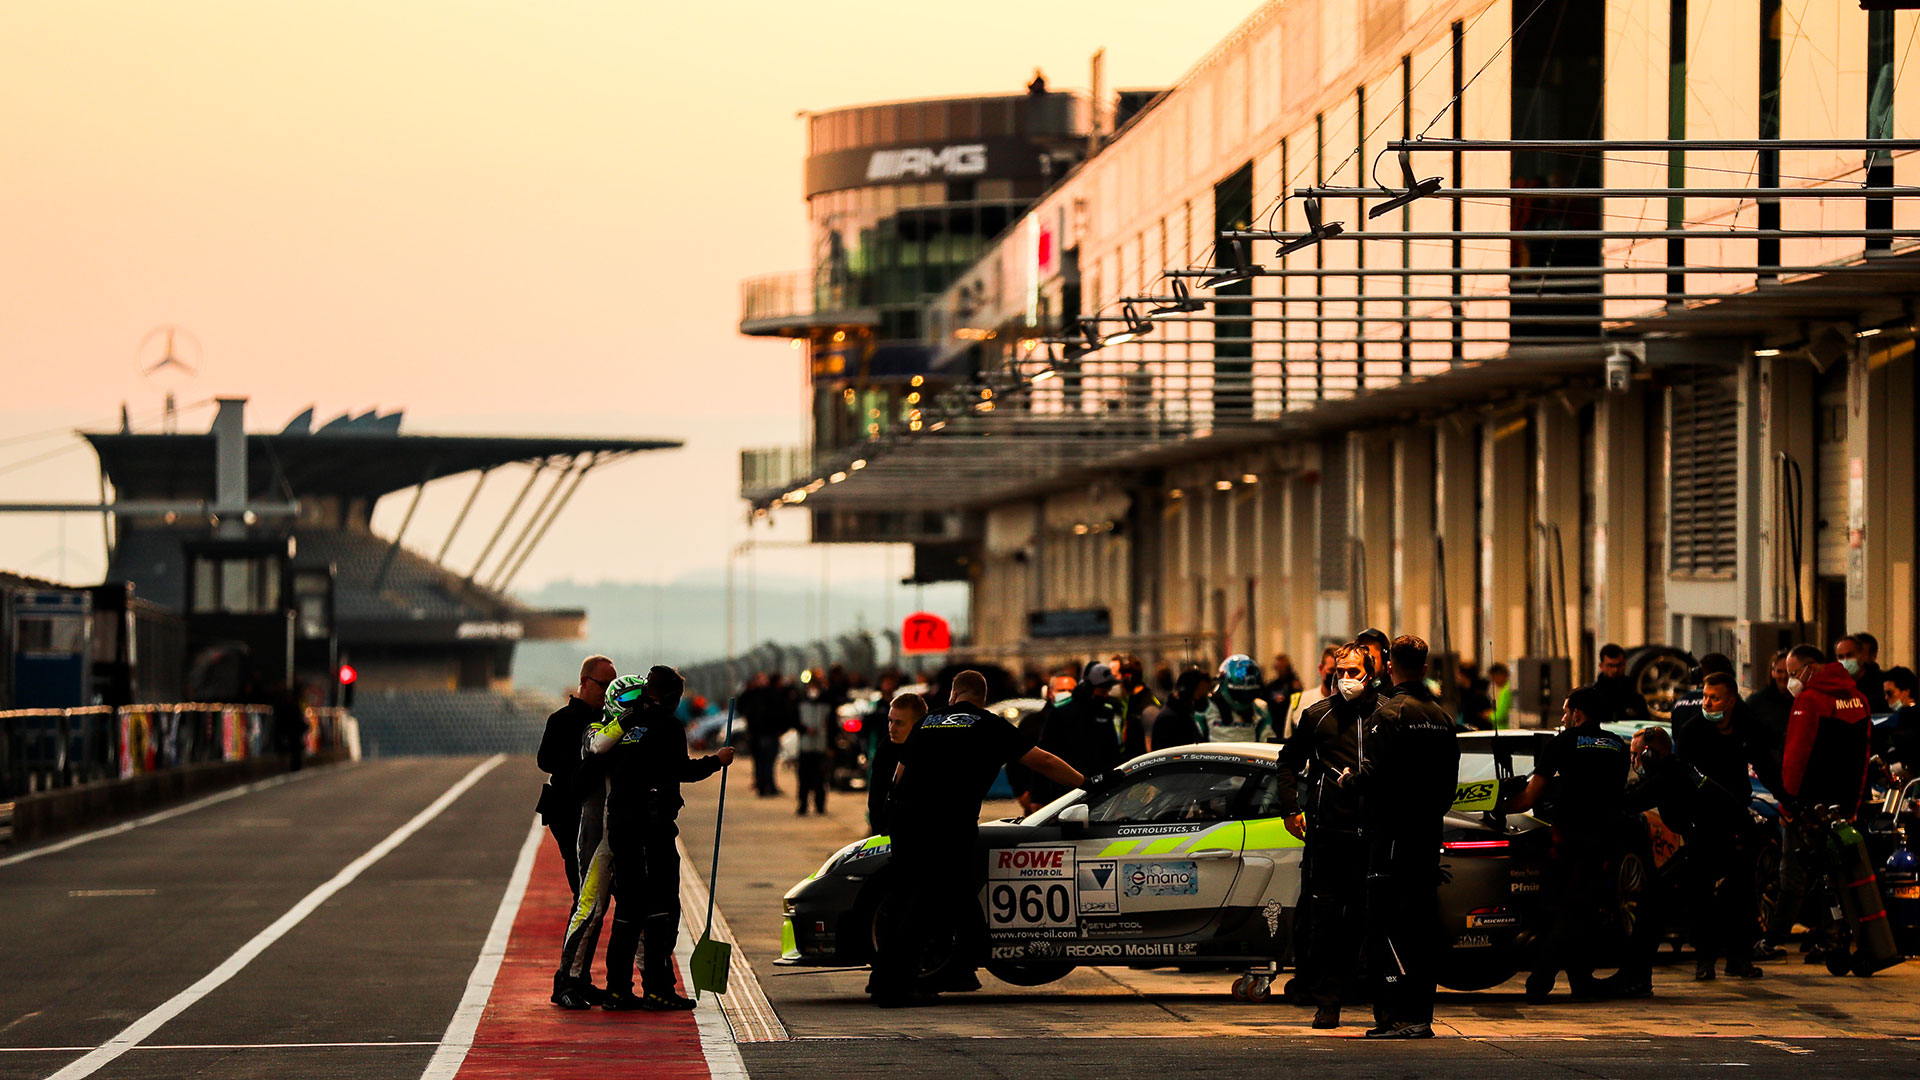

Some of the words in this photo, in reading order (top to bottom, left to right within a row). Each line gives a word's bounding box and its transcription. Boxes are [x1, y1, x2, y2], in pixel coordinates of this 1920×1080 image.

[897, 144, 988, 177] AMG
[1835, 697, 1864, 710] MOTUL
[922, 712, 982, 726] W&S
[1190, 754, 1241, 763] Scheerbarth
[1117, 825, 1189, 836] CONTROLISTICS,
[998, 850, 1065, 868] ROWE
[1020, 869, 1048, 877] MOTOR
[1131, 871, 1189, 886] emano
[992, 884, 1070, 923] 960
[1088, 922, 1117, 930] SETUP
[1118, 921, 1143, 929] TOOL
[990, 929, 1077, 939] www.rowe-oil.com
[991, 945, 1025, 959] KÜS
[1066, 945, 1121, 957] RECARO
[1126, 944, 1162, 956] Mobil
